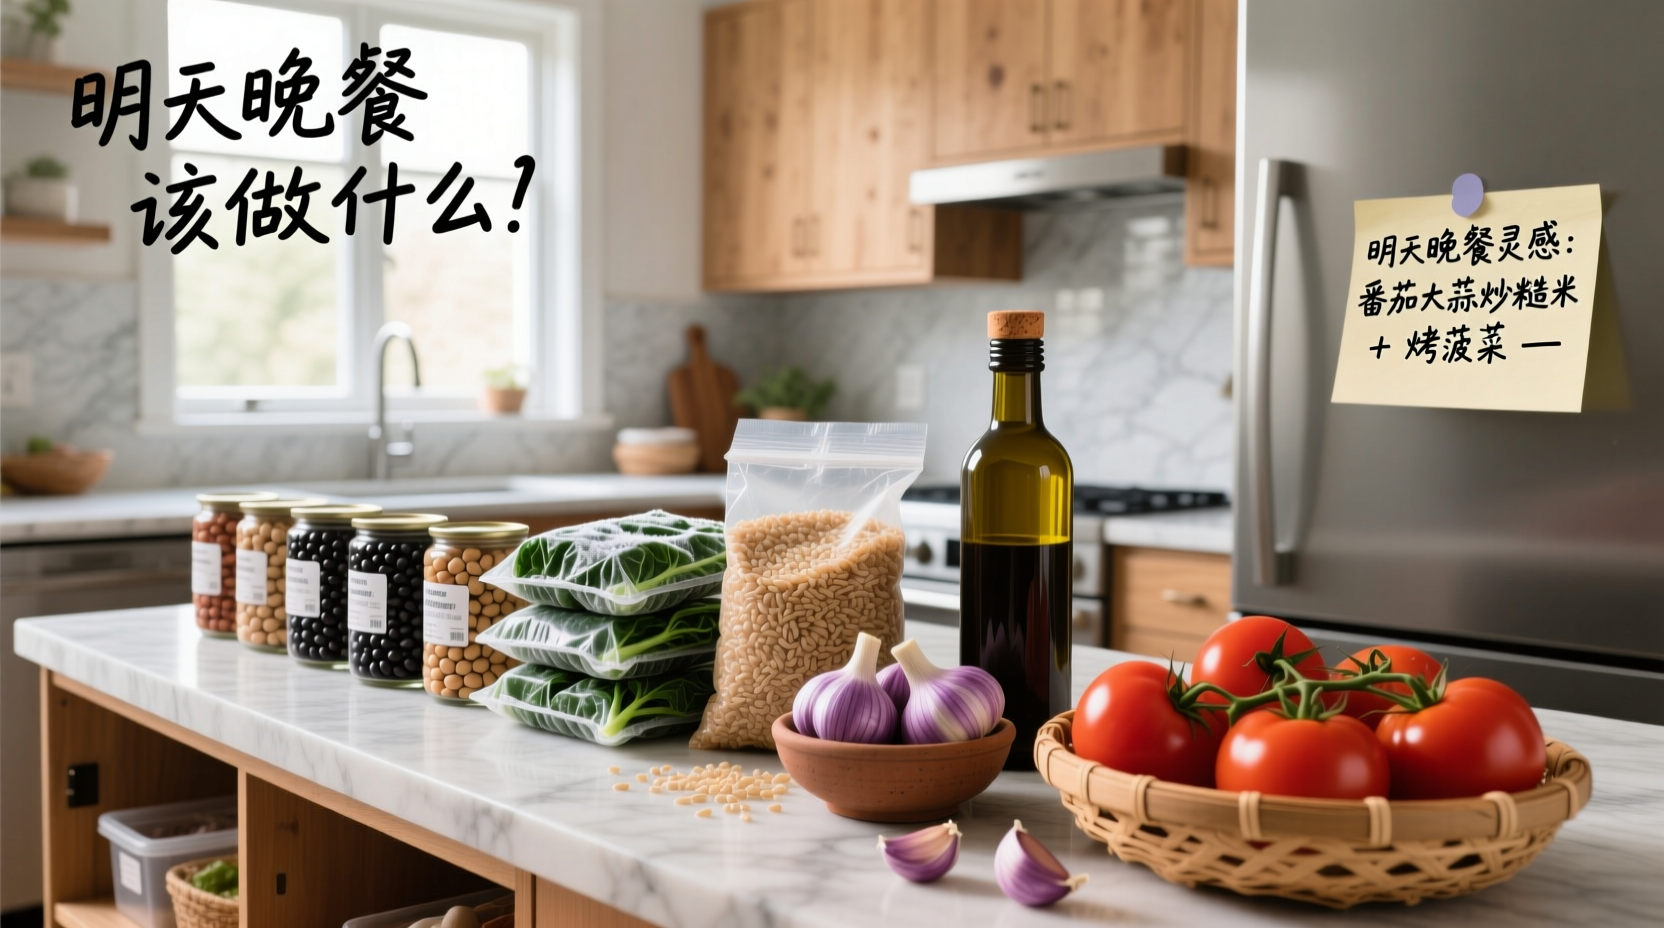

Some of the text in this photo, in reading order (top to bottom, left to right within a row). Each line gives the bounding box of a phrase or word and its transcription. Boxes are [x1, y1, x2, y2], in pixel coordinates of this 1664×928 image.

[1358, 274, 1579, 317] 番茄大蒜炒糙米
[1404, 321, 1507, 365] 烤菠菜
